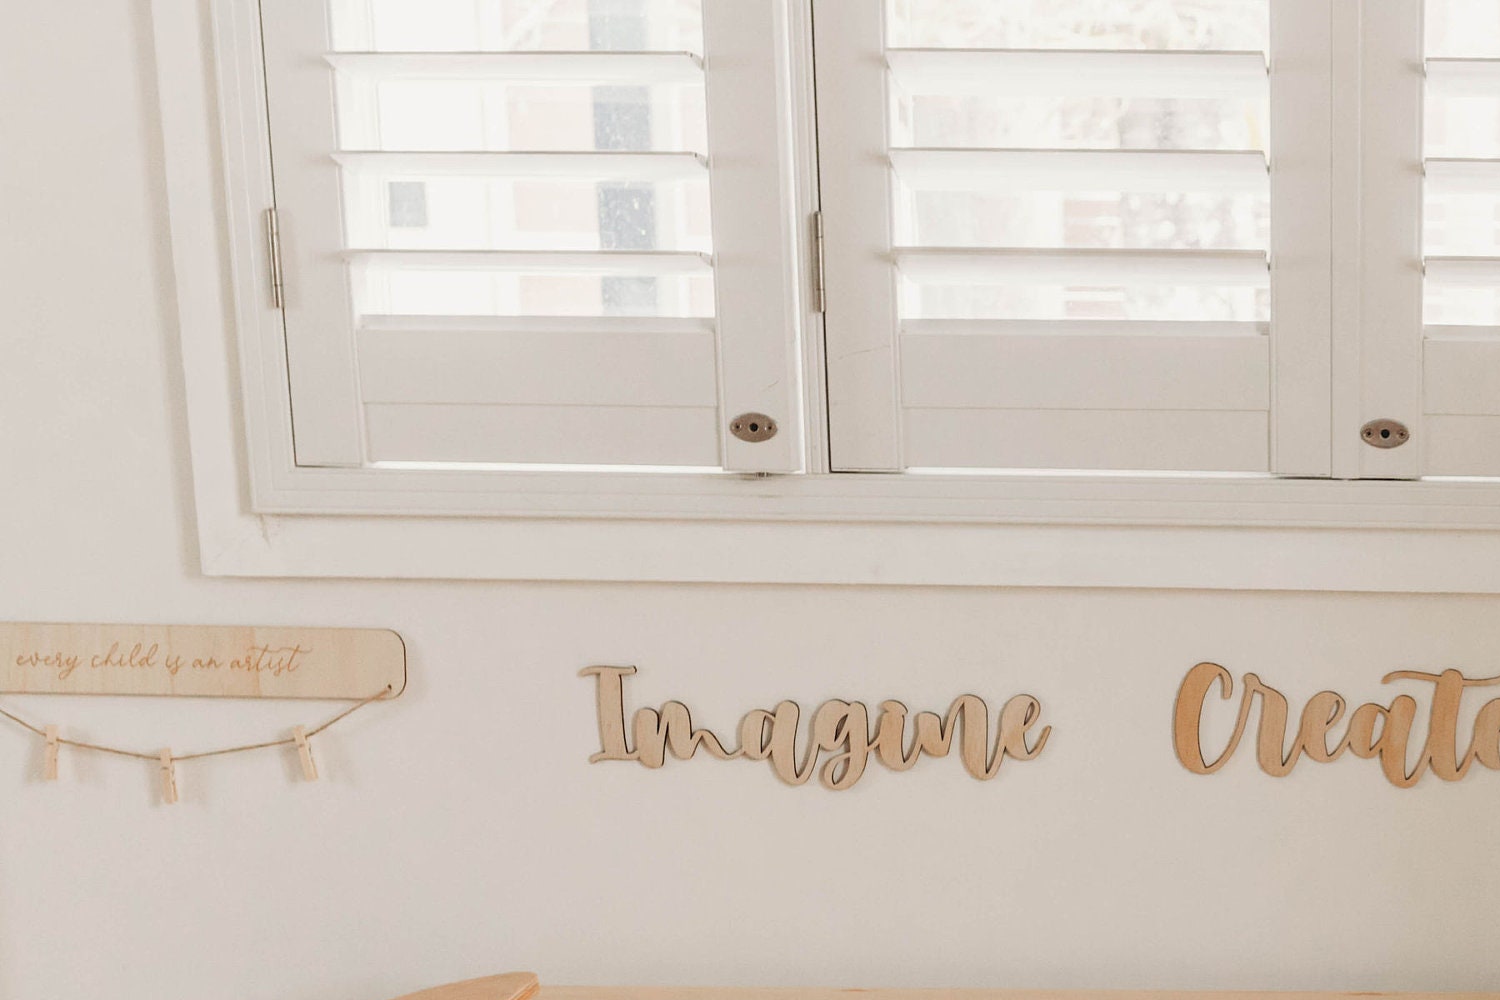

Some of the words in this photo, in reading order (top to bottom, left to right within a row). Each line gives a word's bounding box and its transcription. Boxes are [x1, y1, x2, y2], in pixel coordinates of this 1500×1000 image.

[16, 652, 82, 680] every
[90, 642, 159, 668] child
[165, 655, 184, 676] is
[192, 656, 223, 669] an
[229, 644, 313, 676] artist
[578, 662, 1053, 791] Imagine
